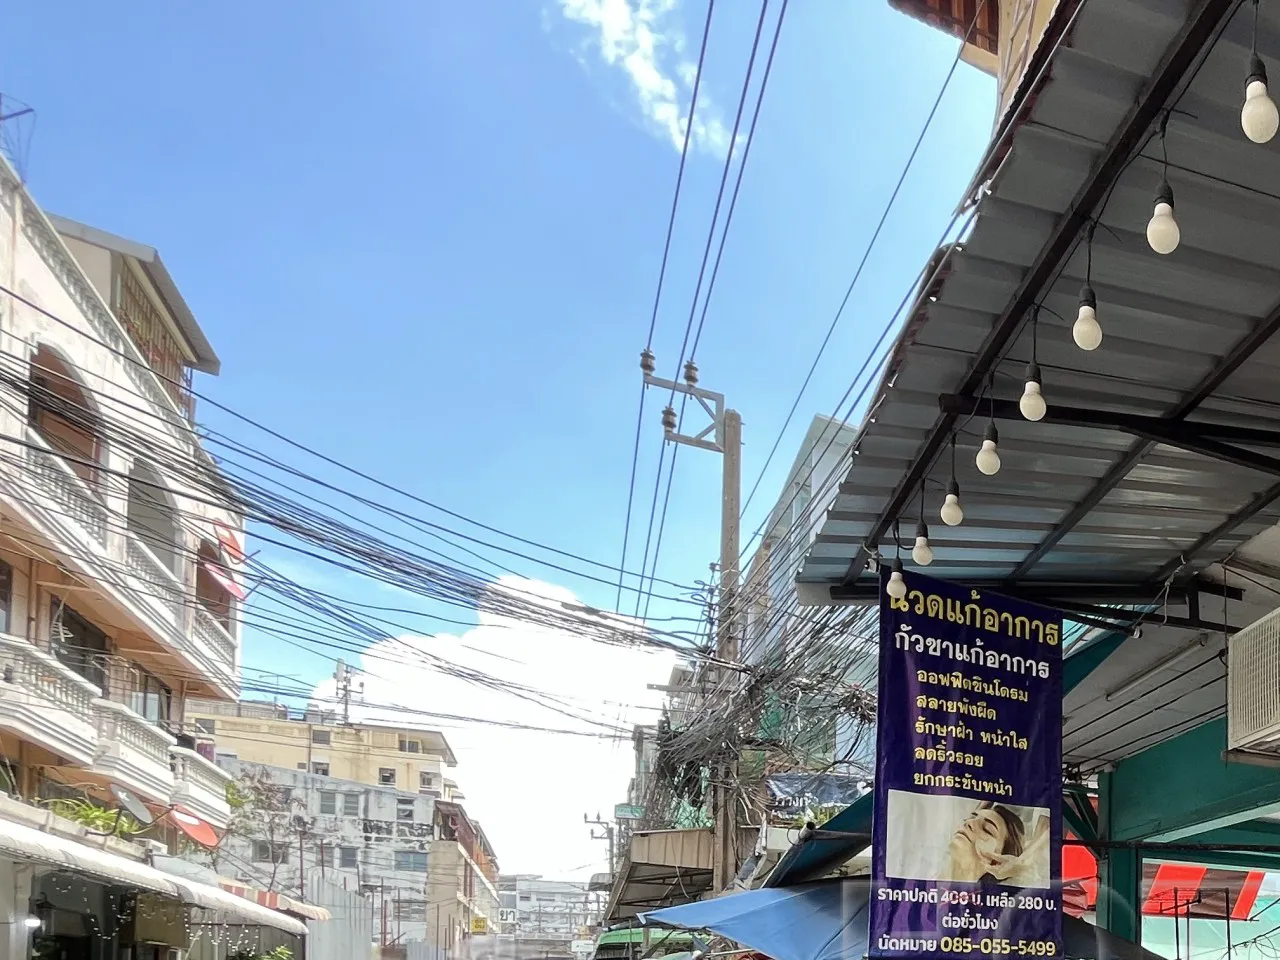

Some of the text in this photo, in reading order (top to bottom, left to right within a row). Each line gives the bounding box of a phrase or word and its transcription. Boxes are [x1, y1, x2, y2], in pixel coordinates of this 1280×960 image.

[980, 731, 1028, 750] หน้าใส
[914, 740, 984, 767] ลดริ้วรอย
[878, 888, 937, 903] ราคาปกติ
[986, 893, 1015, 908] เหลือ
[1018, 896, 1042, 910] 280
[1046, 899, 1057, 911] บ.
[942, 909, 998, 930] ต่อชั่วโมง
[940, 937, 1056, 956] 085-055-5499
